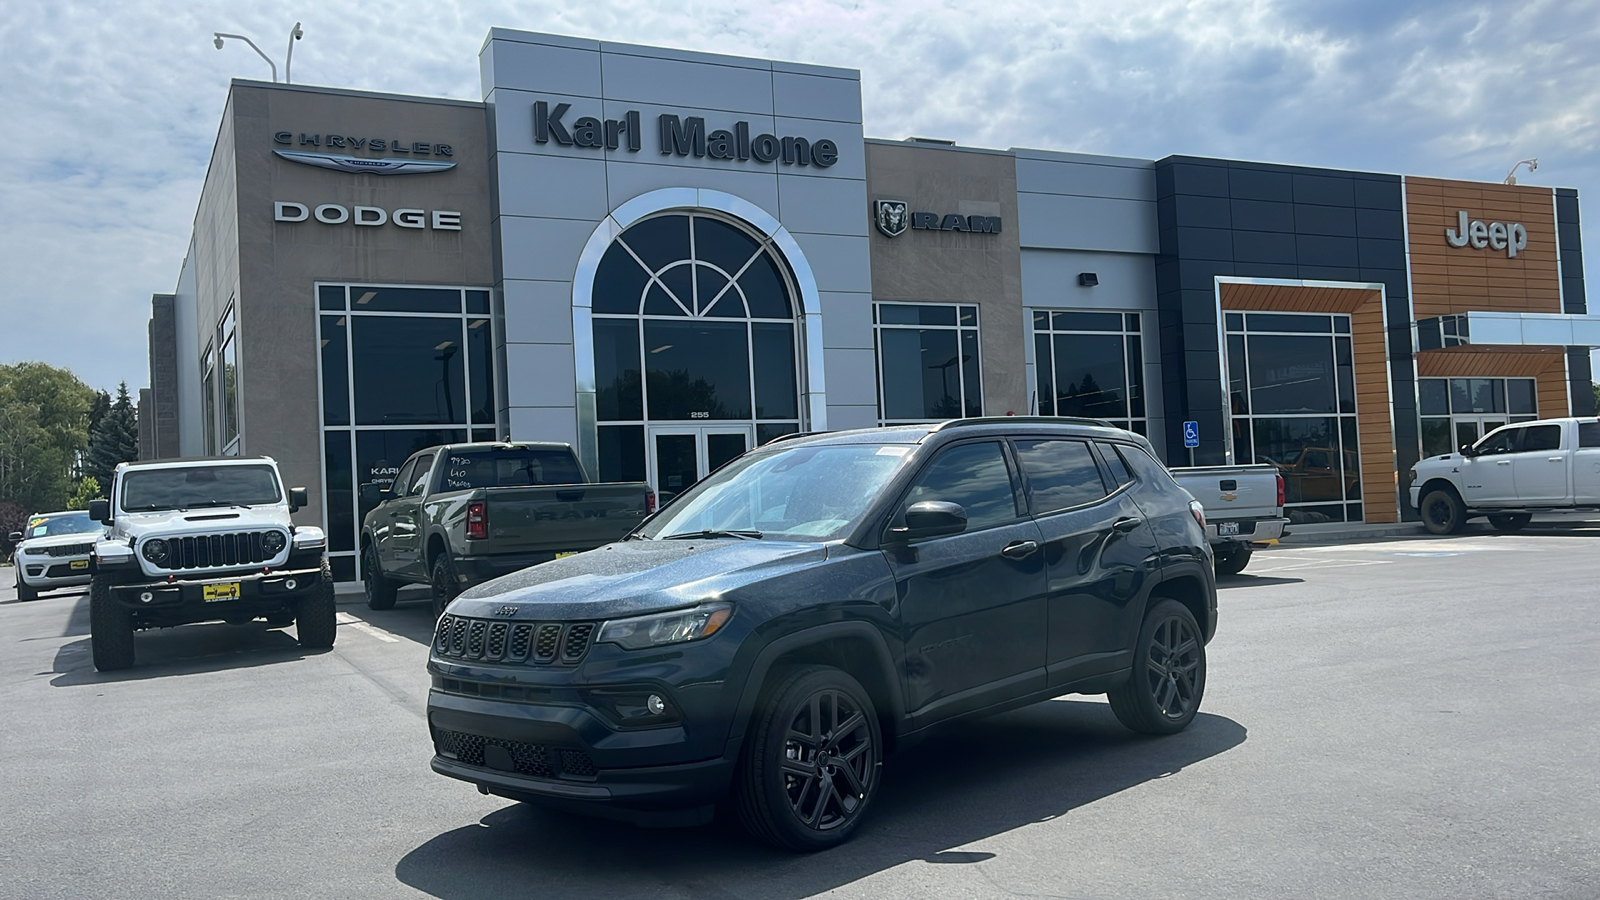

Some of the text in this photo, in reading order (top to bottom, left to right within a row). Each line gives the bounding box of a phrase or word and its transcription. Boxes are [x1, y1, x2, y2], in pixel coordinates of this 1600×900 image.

[274, 131, 453, 156] CHRYSLER
[534, 101, 839, 168] Karl Malone
[274, 201, 462, 231] DODGE
[911, 211, 1002, 234] RAM
[1445, 210, 1527, 258] Jeep
[533, 508, 607, 521] RAM
[495, 605, 518, 617] Jeep
